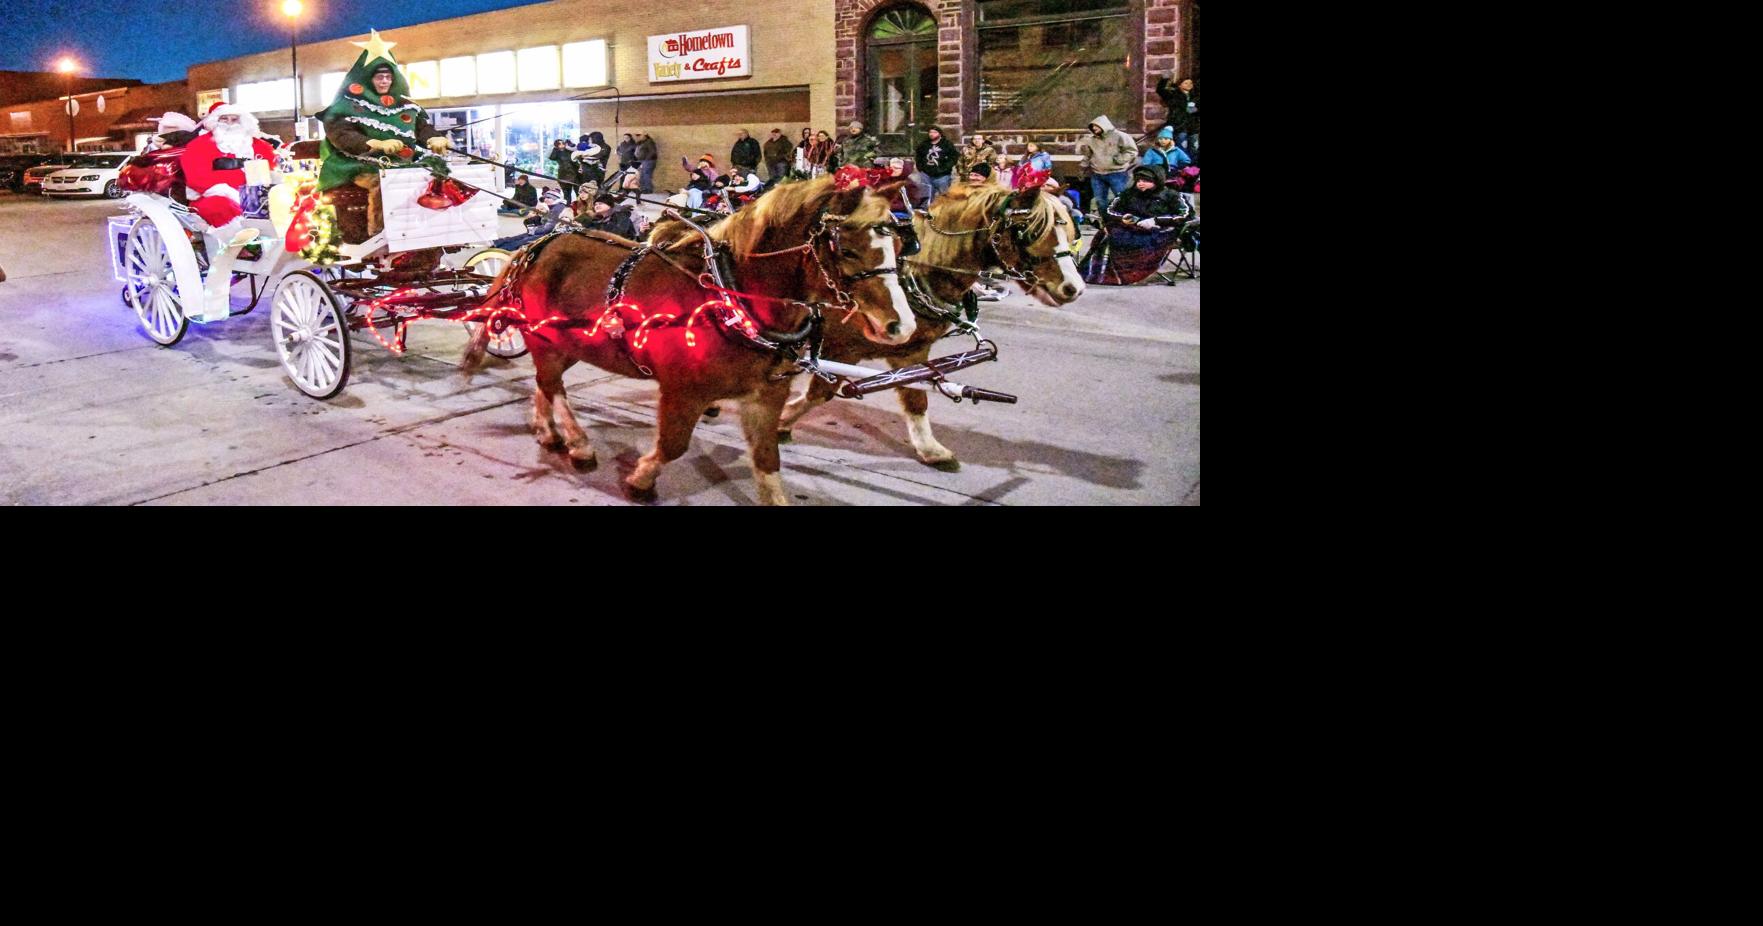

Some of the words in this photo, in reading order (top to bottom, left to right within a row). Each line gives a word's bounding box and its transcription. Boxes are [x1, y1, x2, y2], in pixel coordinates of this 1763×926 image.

[679, 32, 734, 56] Hometown
[684, 63, 691, 71] &
[693, 57, 741, 75] Crafts
